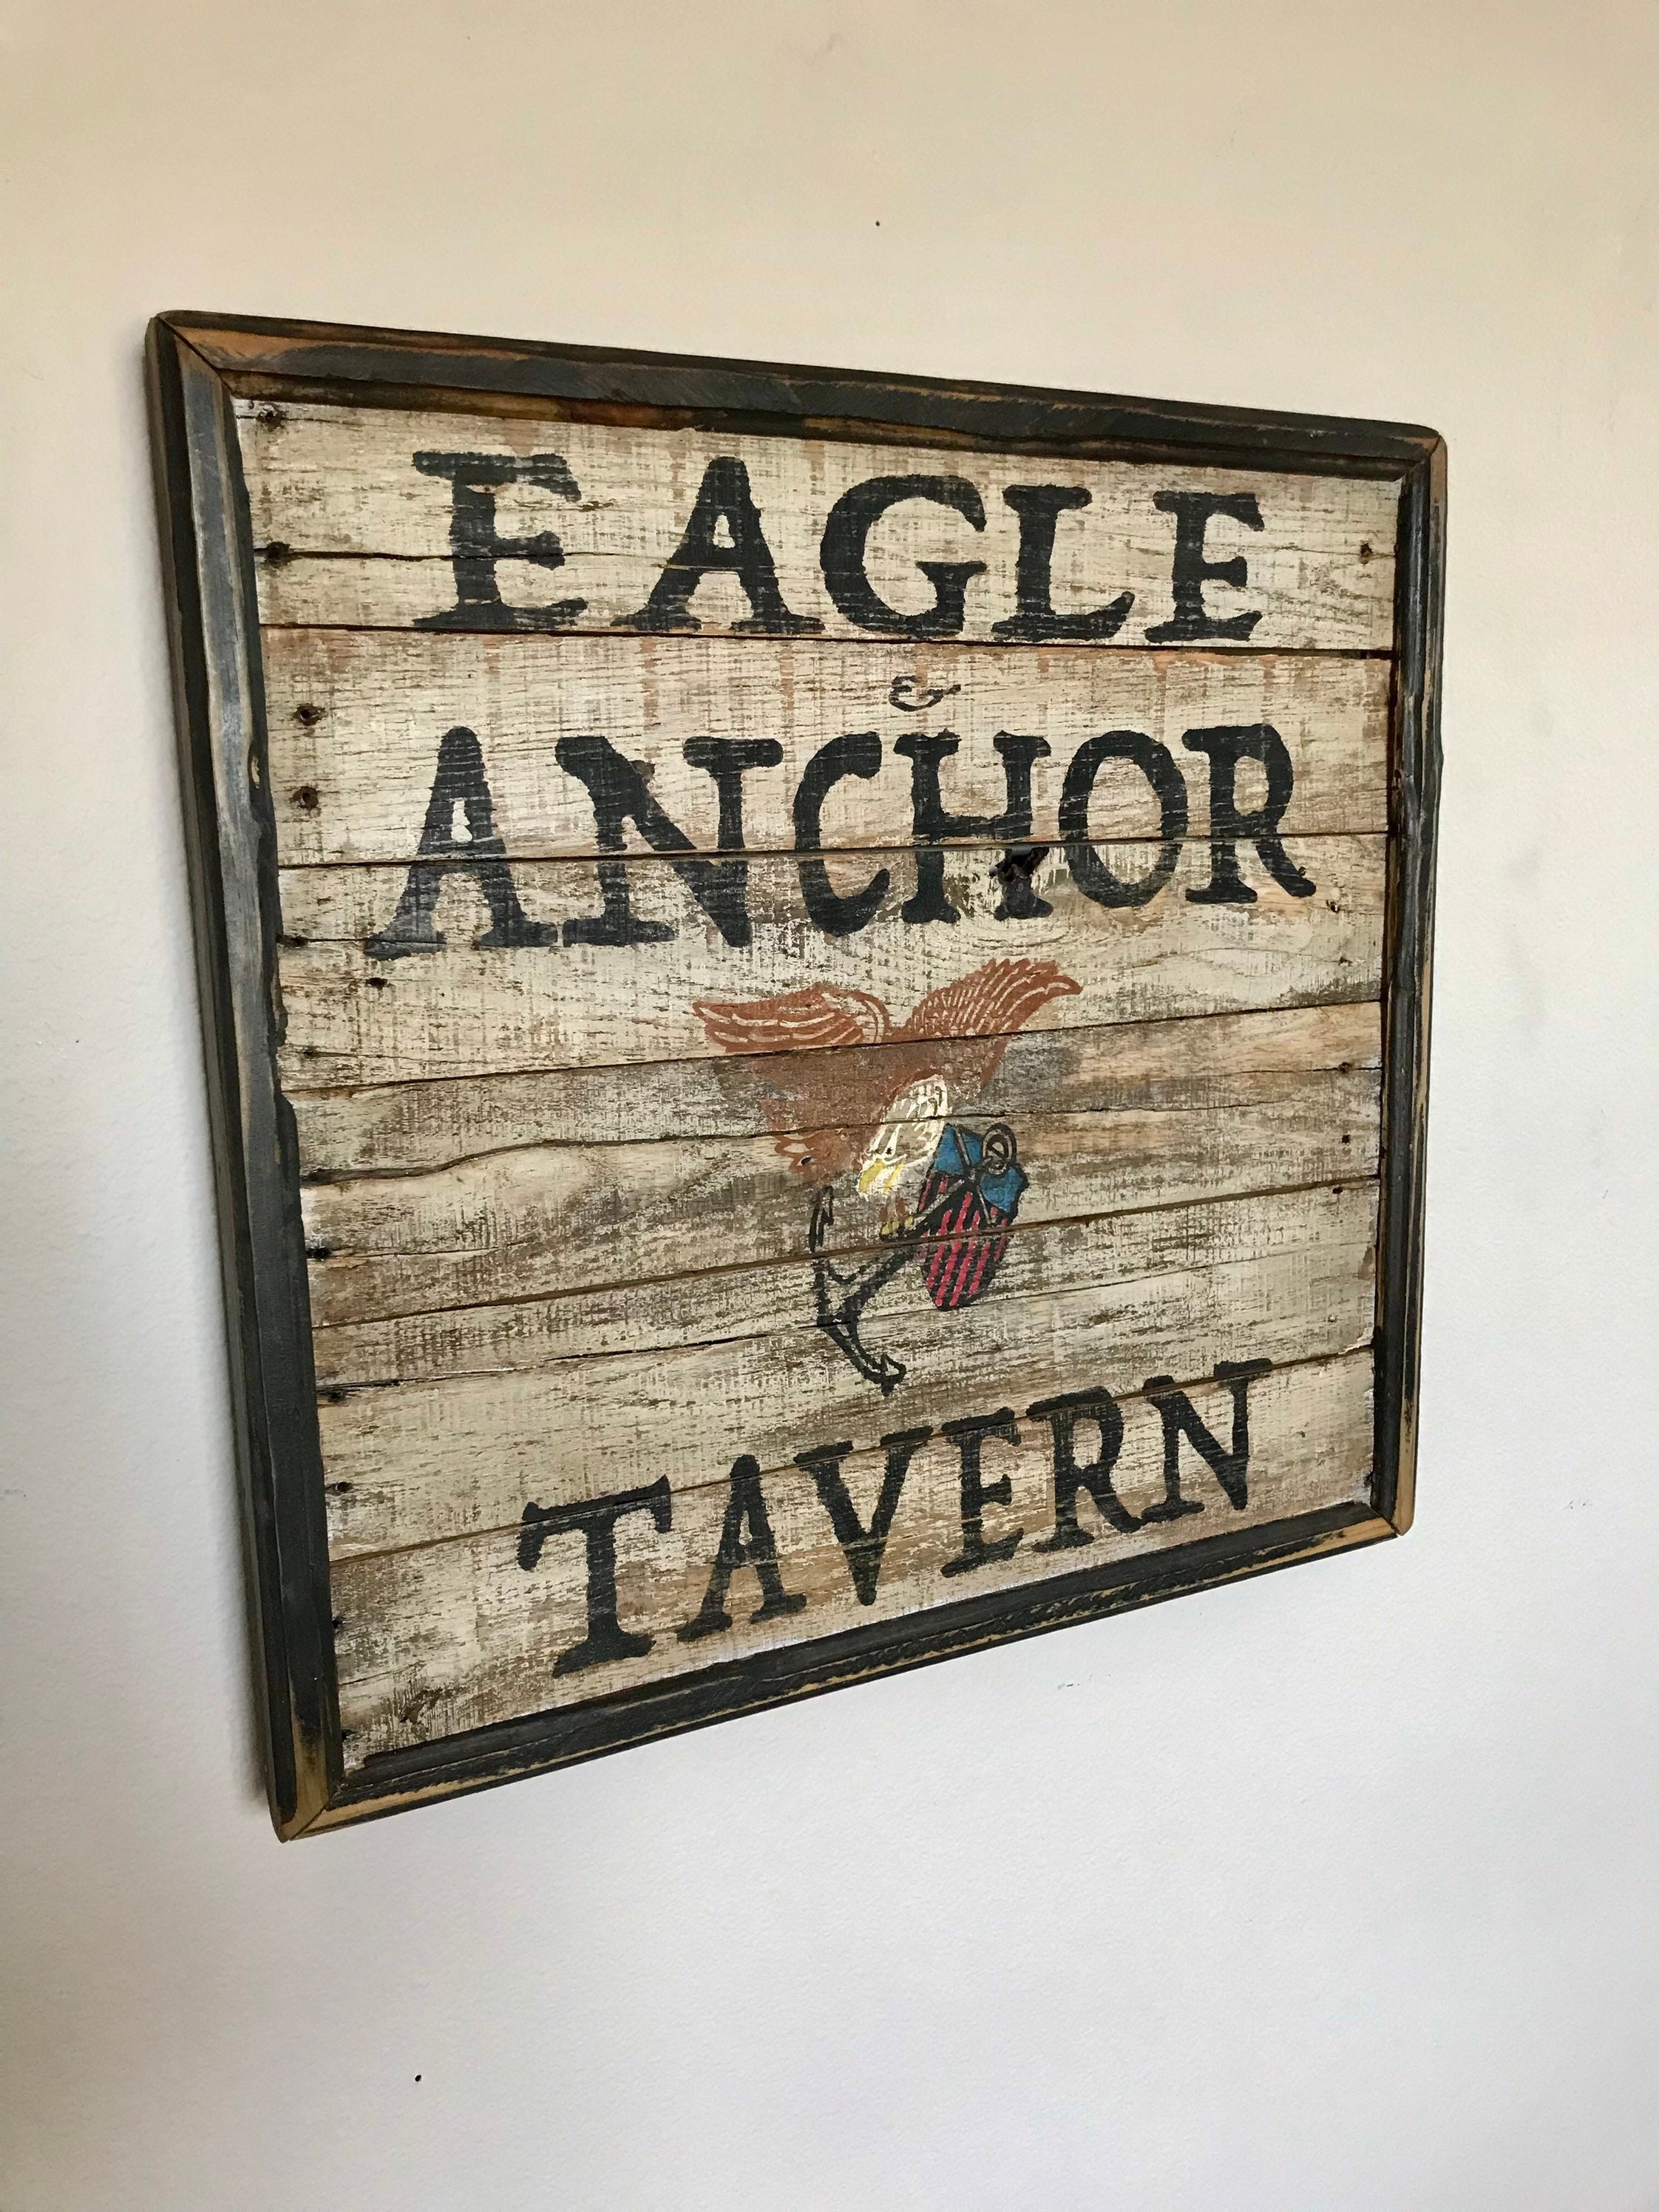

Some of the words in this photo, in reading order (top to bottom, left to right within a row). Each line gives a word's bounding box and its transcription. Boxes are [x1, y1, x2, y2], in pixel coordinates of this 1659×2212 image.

[414, 451, 1266, 642] EAGLE
[889, 675, 961, 711] &
[368, 723, 1316, 957] ANCHOR
[518, 1358, 1272, 1678] TAVERN
